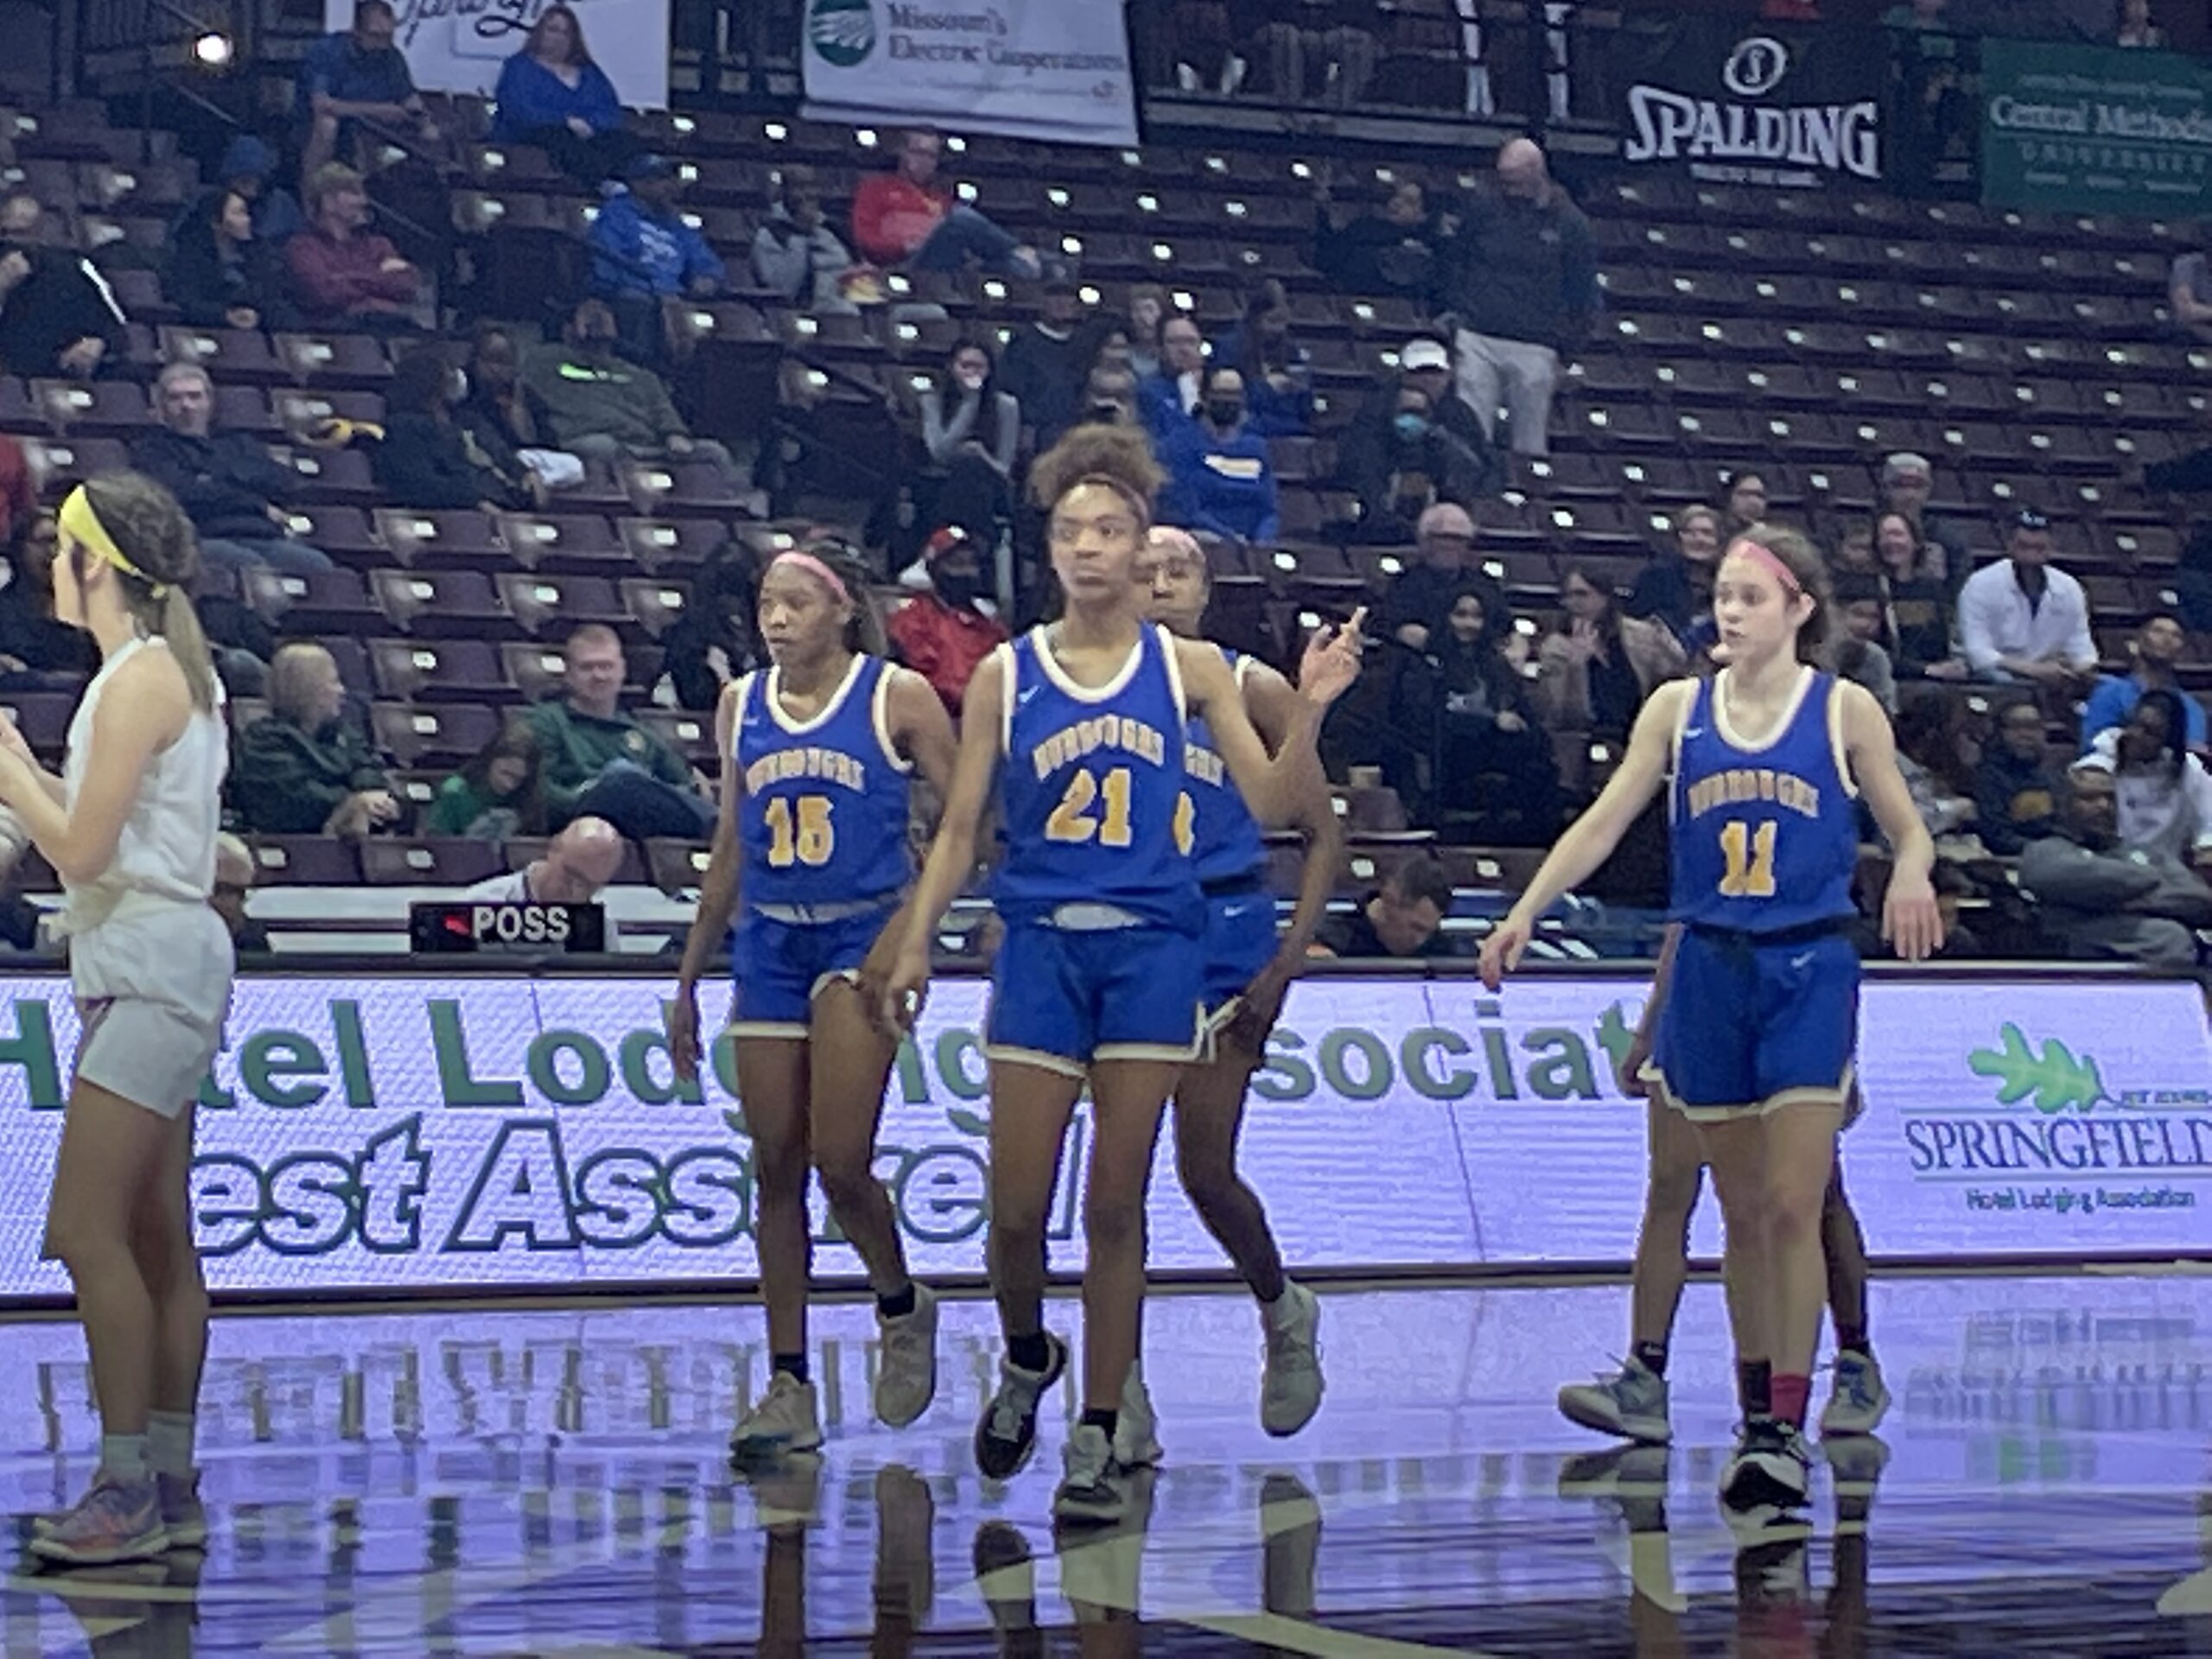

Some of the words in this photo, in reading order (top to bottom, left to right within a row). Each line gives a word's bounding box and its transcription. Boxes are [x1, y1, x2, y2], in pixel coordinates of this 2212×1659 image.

[1625, 85, 1880, 179] SPALDING
[1045, 768, 1132, 847] 21
[1717, 820, 1777, 896] 11
[473, 906, 570, 942] POSS
[1904, 1117, 2212, 1171] SPRINGFIELD
[191, 1111, 433, 1256] est
